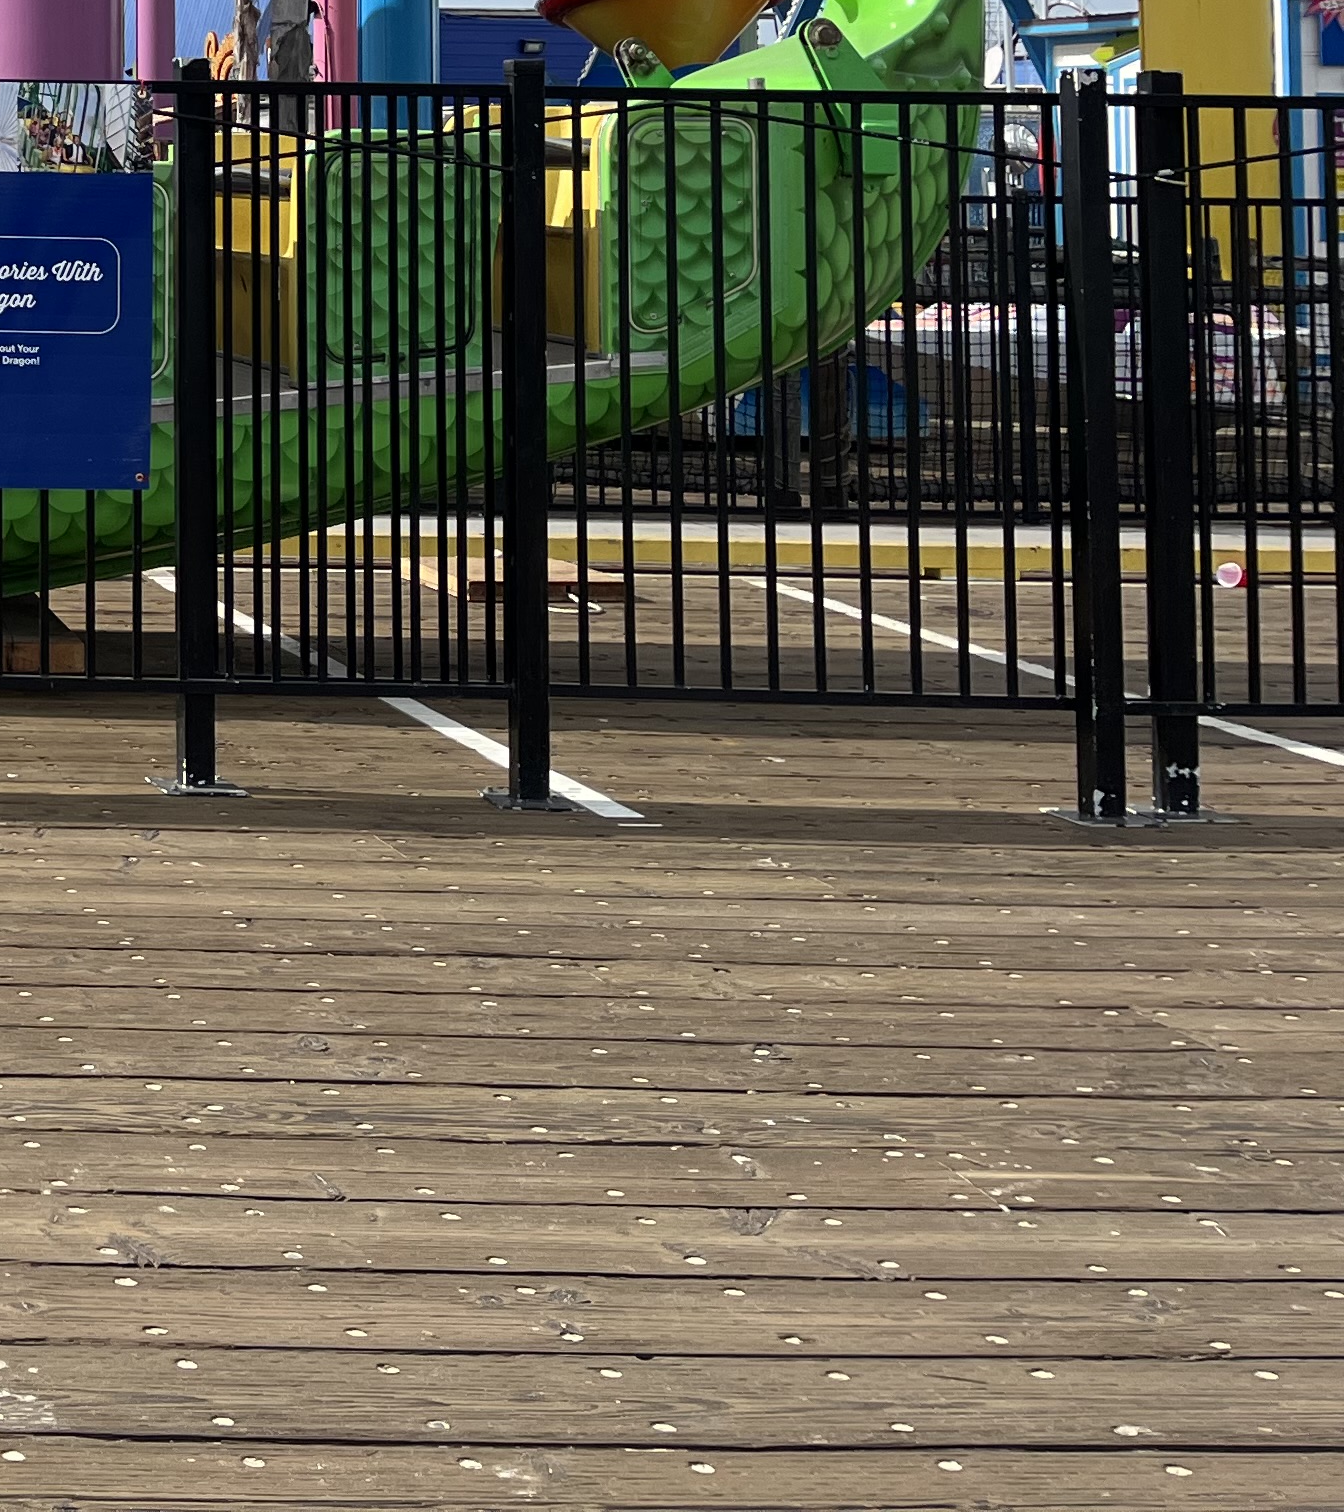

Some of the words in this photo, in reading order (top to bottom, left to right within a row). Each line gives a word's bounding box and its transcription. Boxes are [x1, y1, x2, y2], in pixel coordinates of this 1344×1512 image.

[51, 260, 104, 282] With
[17, 344, 40, 353] Your
[2, 356, 40, 367] Dragon!
